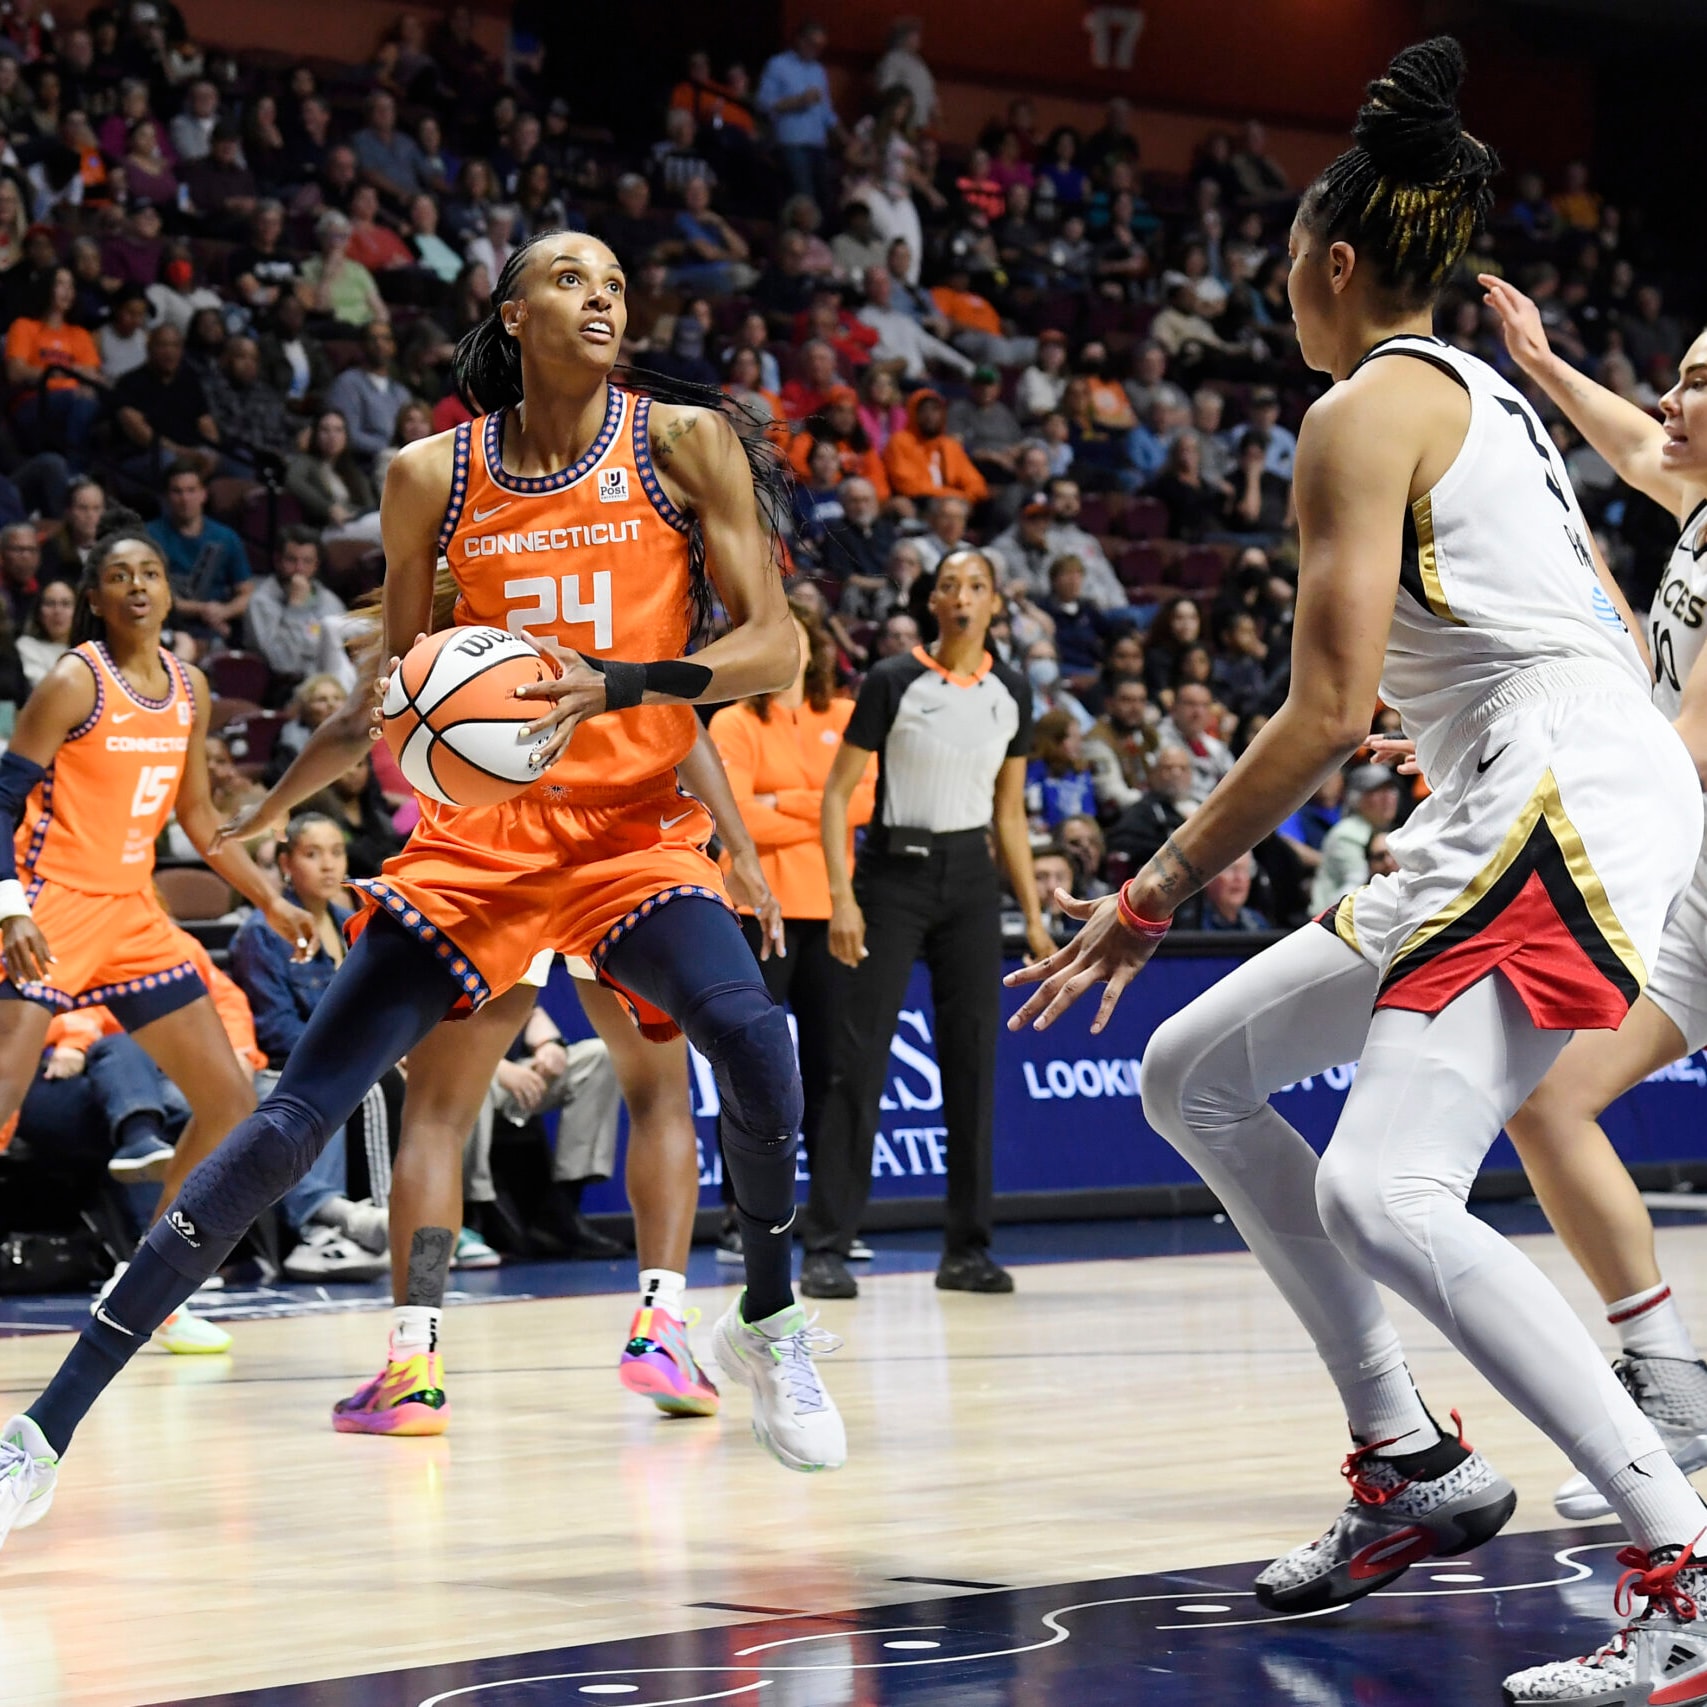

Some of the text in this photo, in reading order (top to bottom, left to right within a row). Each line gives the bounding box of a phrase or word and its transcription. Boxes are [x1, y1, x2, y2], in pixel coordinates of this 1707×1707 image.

[1082, 8, 1144, 69] 17
[600, 485, 626, 496] Post
[465, 520, 641, 557] CONNECTICUT
[504, 570, 613, 650] 24
[1652, 621, 1682, 692] 10
[131, 766, 178, 817] 15
